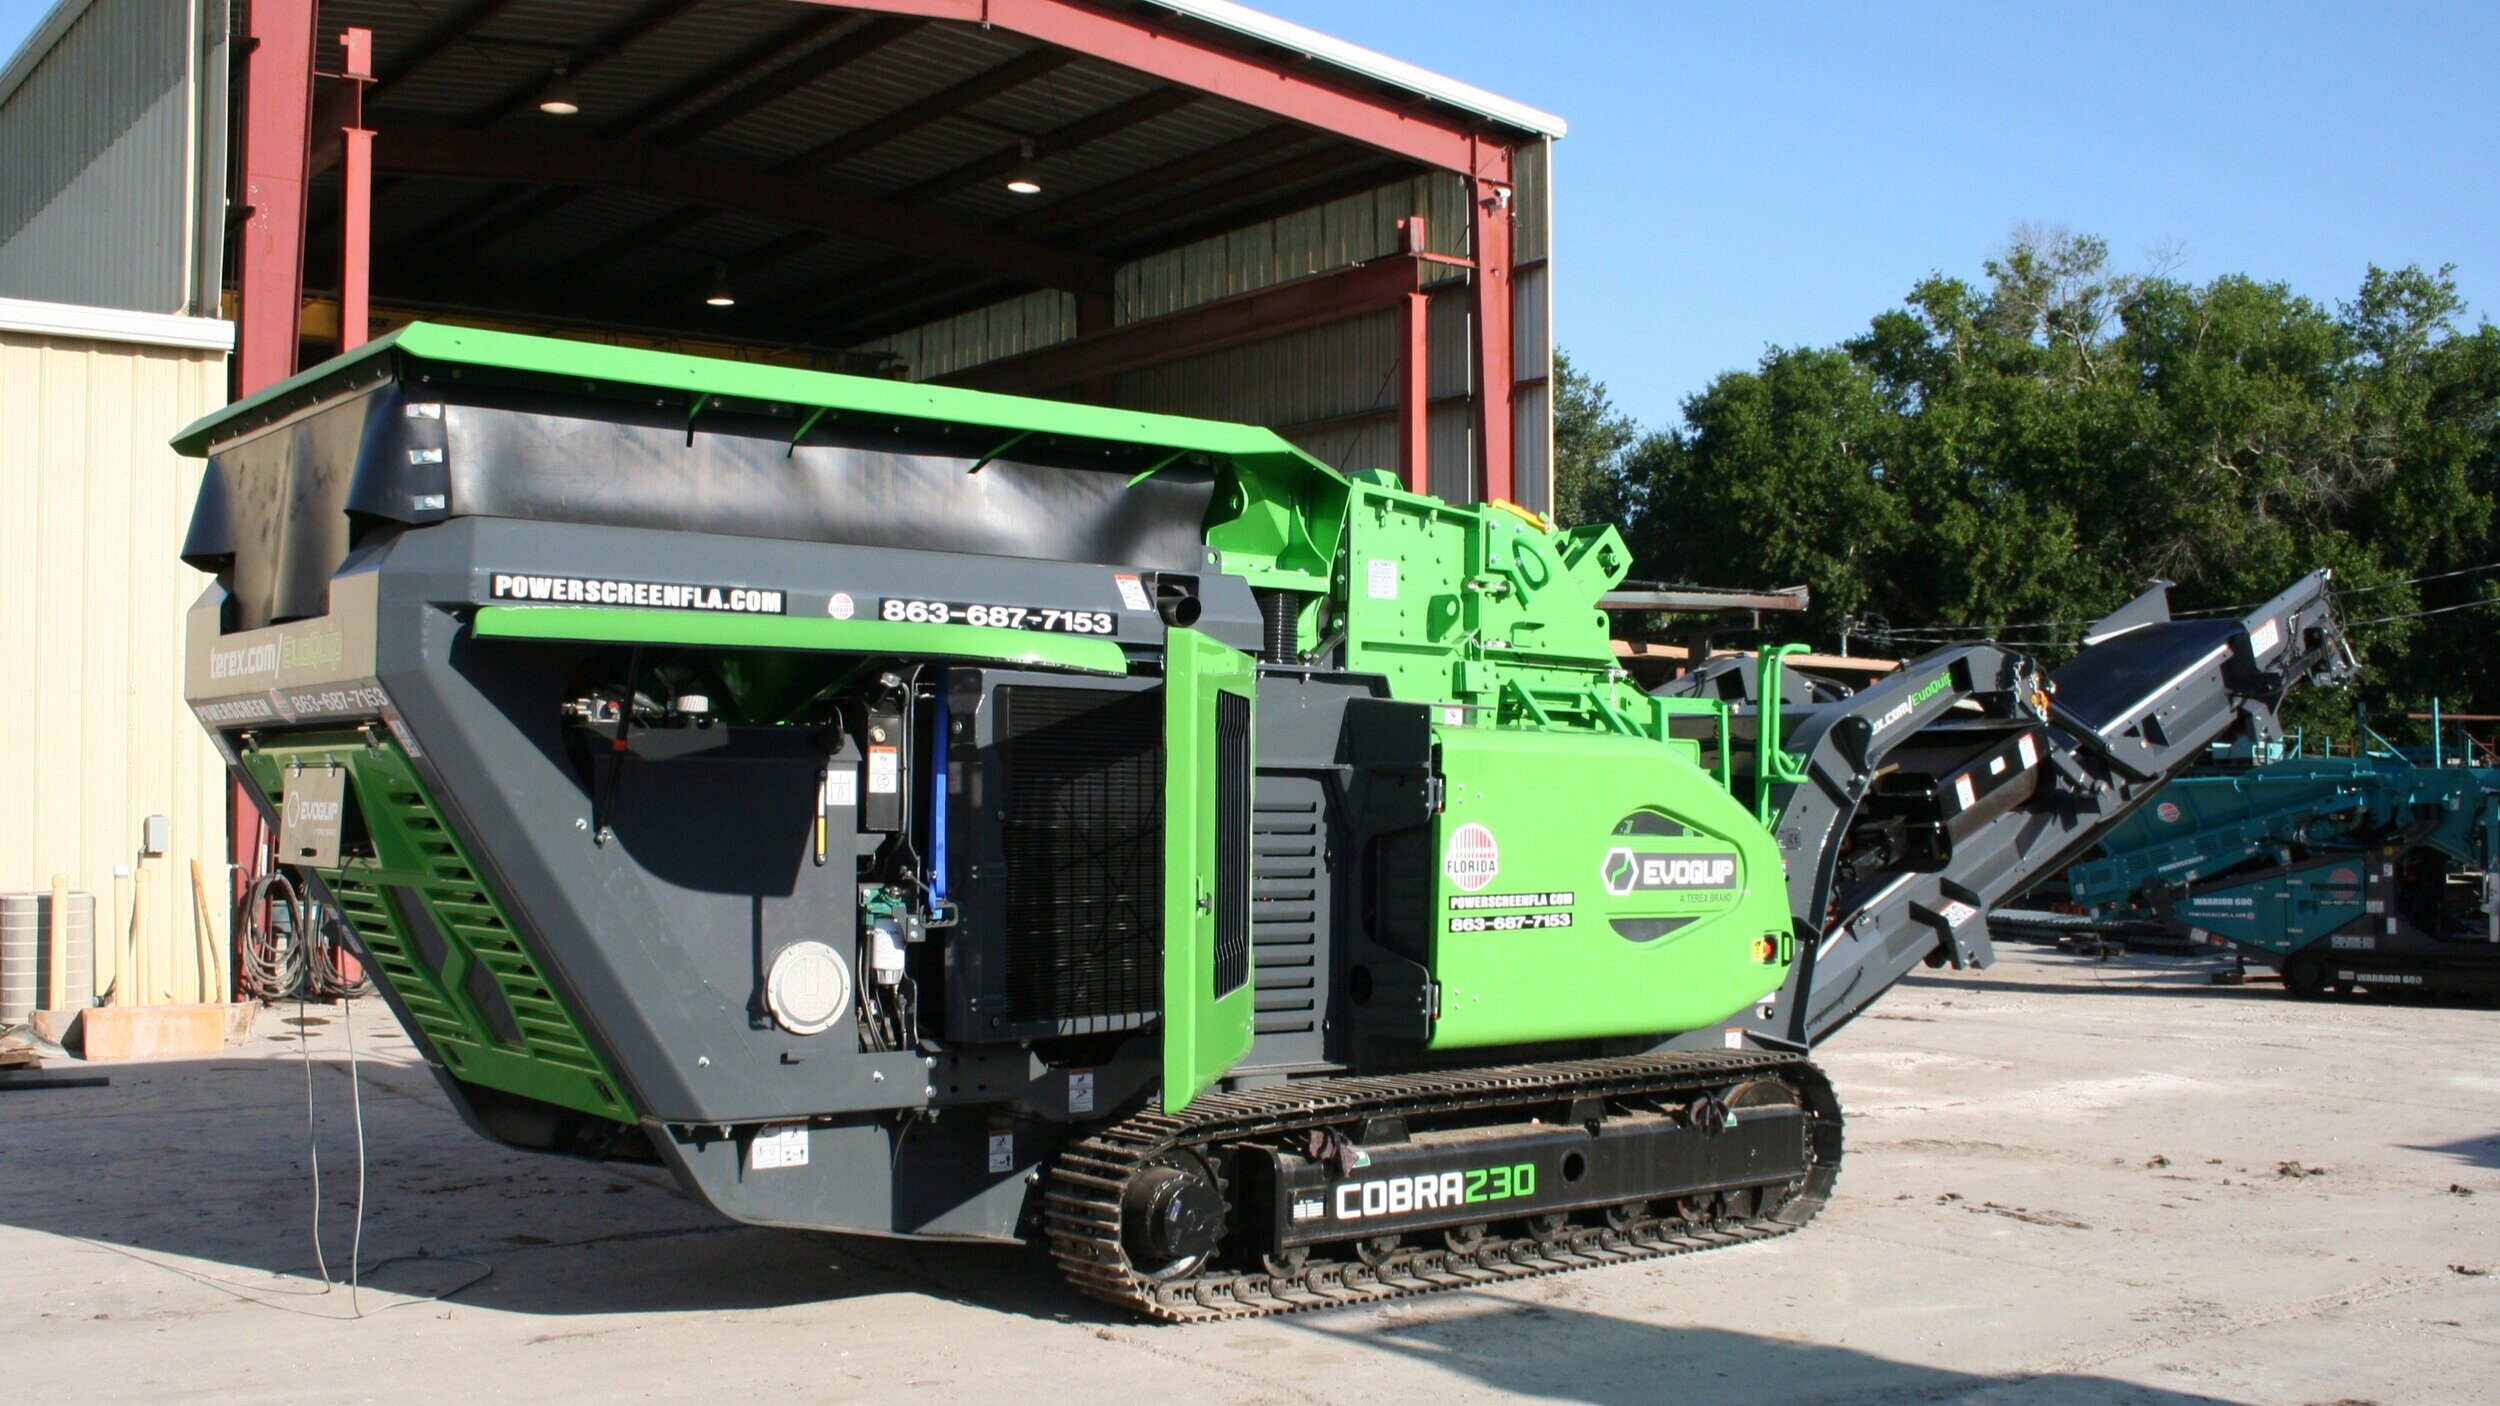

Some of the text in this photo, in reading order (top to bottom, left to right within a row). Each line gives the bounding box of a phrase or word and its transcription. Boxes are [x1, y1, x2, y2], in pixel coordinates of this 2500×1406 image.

[495, 575, 782, 613] POWERSCREENFLA.COM
[882, 599, 1114, 634] 863-687-7153
[194, 687, 389, 722] POWERSCREEN 863-687-7153
[301, 800, 339, 821] EVOQUIP
[1447, 860, 1496, 873] FLORIDA
[1643, 860, 1734, 885] EVOQUIP
[1679, 893, 1733, 903] A TEREX BRAND
[2193, 898, 2253, 906] WARRIOR 600
[1450, 913, 1571, 932] 863-687-7153
[2356, 973, 2401, 983] WARRIOR
[2402, 975, 2423, 984] 600
